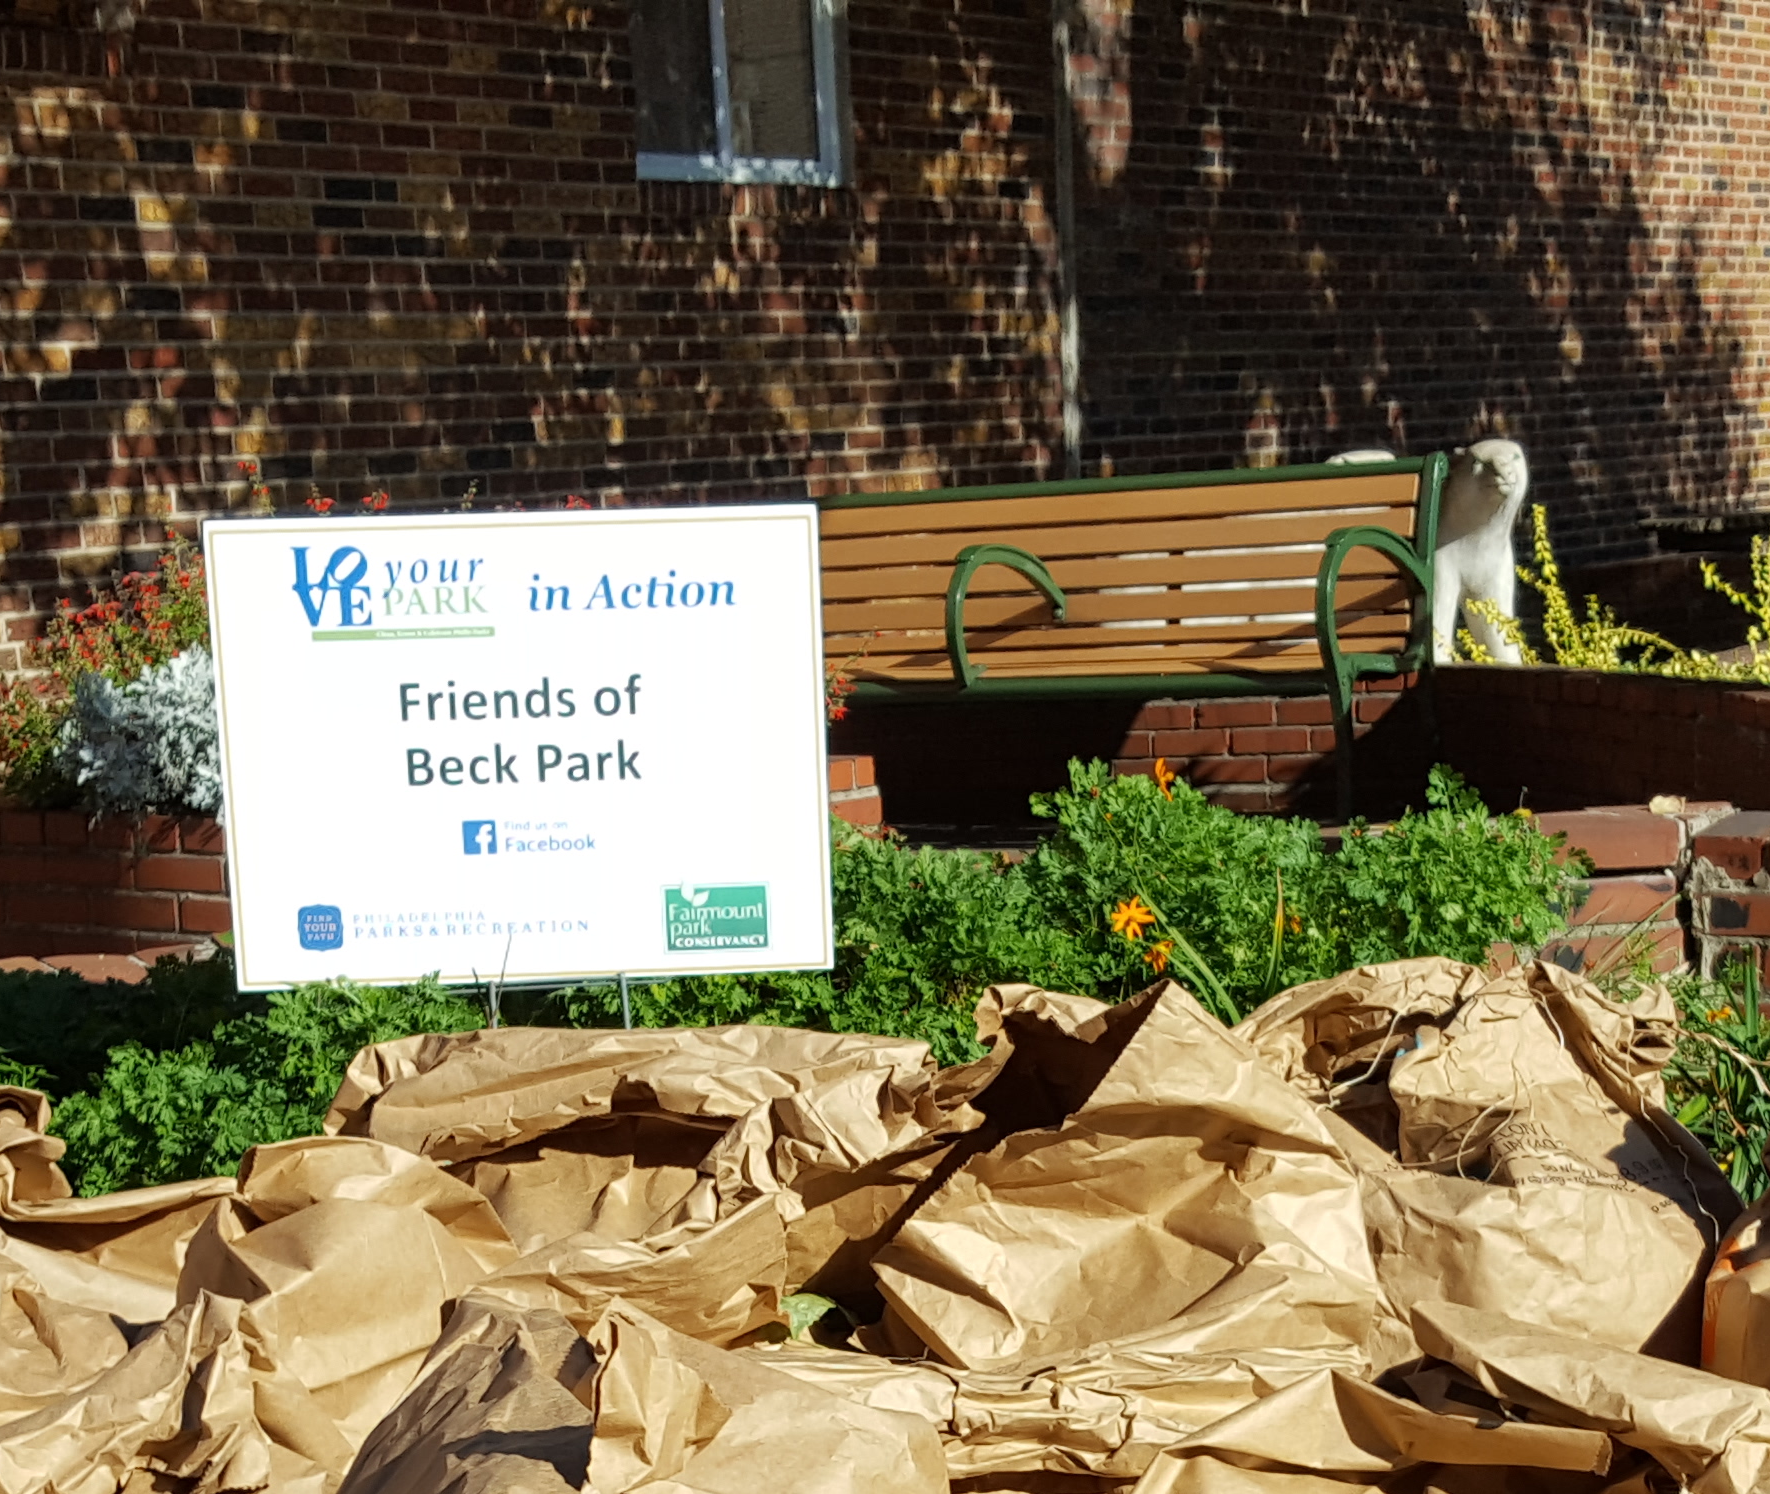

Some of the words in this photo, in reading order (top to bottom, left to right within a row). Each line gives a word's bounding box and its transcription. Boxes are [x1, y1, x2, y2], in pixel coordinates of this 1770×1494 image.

[383, 558, 484, 599] your
[528, 573, 571, 611] in
[582, 569, 737, 609] Action
[382, 585, 489, 616] PARK
[399, 676, 577, 722] Friends
[593, 673, 642, 717] of
[406, 742, 519, 787] Beck
[537, 739, 642, 783] Park
[505, 834, 596, 852] Facebook
[668, 902, 765, 921] Fairmount
[304, 923, 337, 932] YOUR
[669, 917, 713, 945] park
